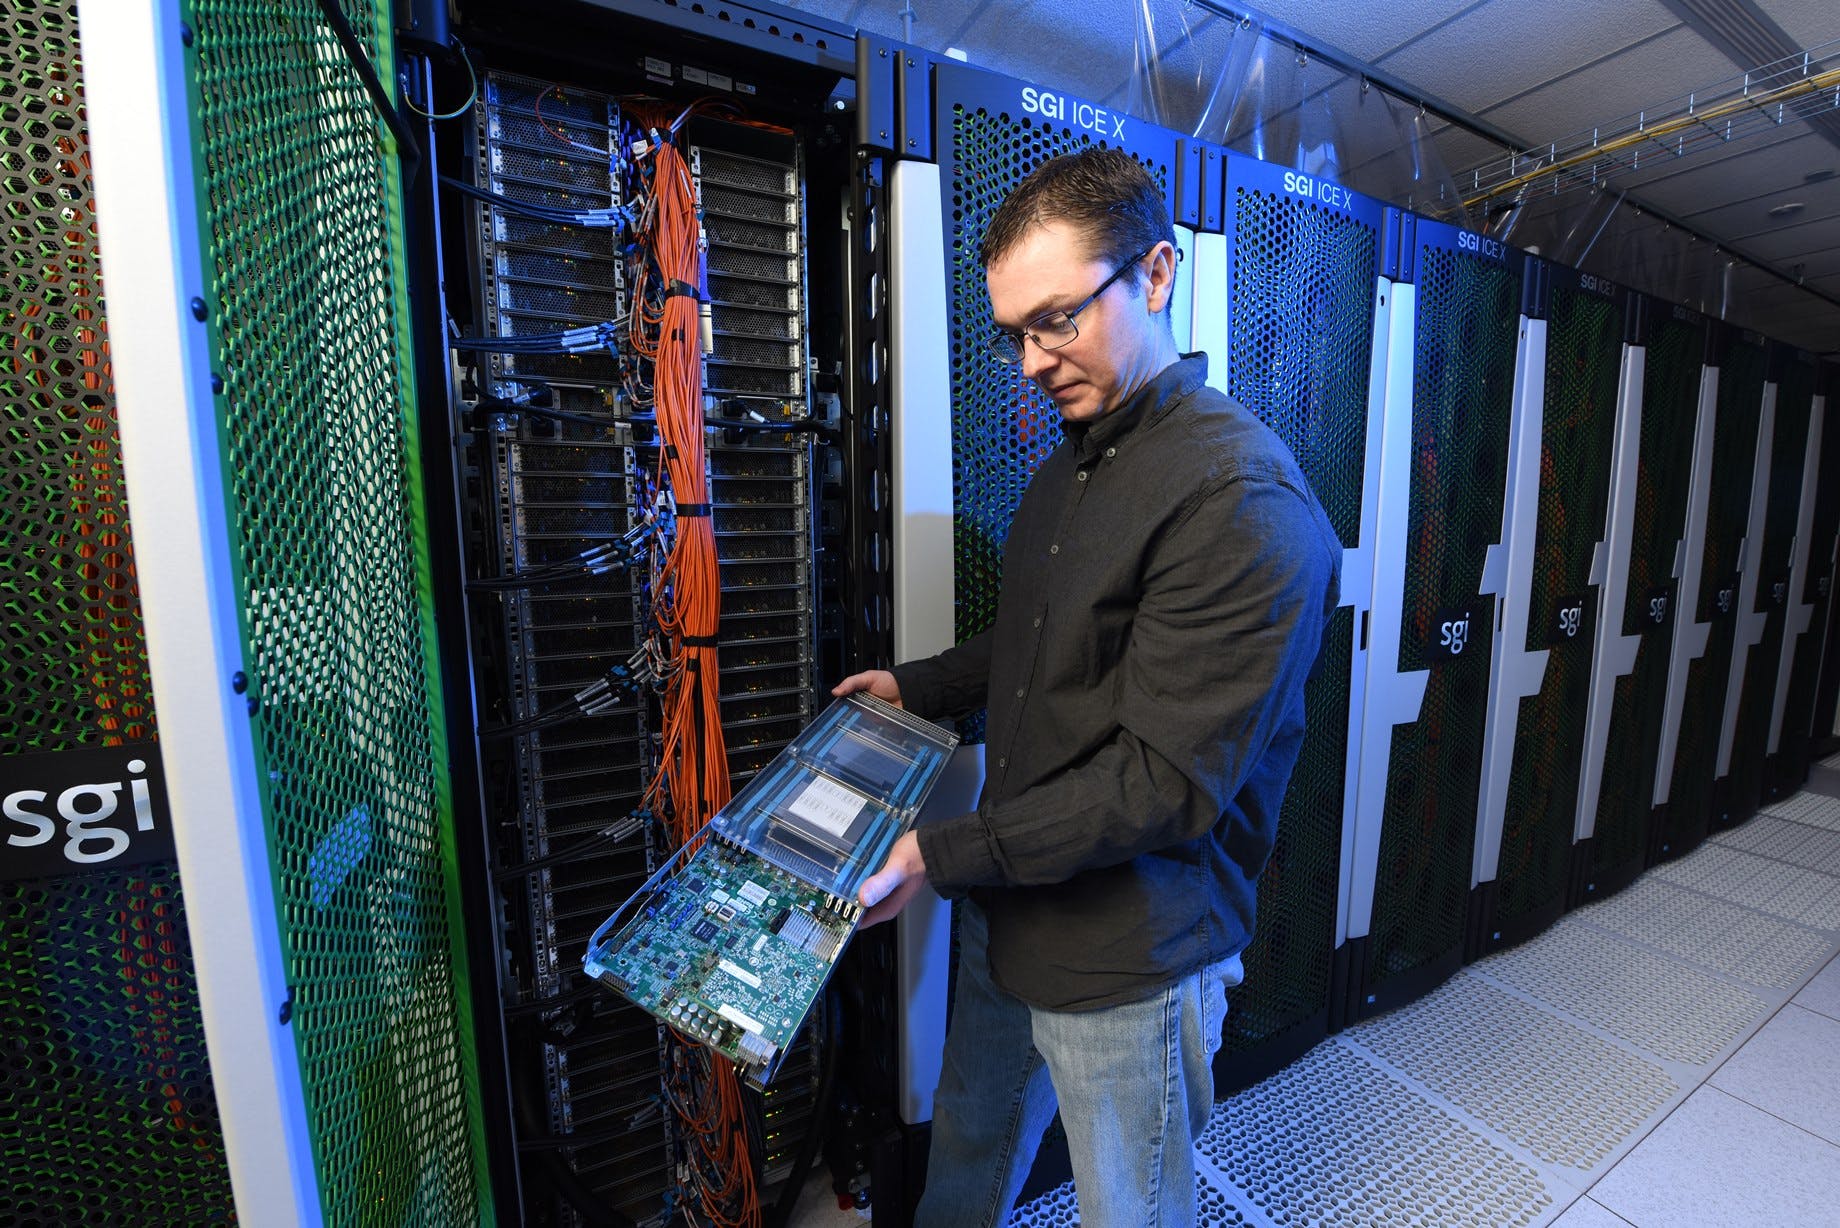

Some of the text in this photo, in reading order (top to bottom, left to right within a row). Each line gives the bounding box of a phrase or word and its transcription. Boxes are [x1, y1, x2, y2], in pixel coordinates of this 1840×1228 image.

[1021, 87, 1126, 142] SGI ICE X
[1283, 171, 1353, 212] SGI ICE X
[1457, 231, 1507, 262] SGI ICE X
[1580, 273, 1598, 293] SGI
[1559, 600, 1583, 637] sgi
[1649, 591, 1668, 623] sgi
[1440, 612, 1470, 655] sgi
[2, 759, 155, 864] sgi
